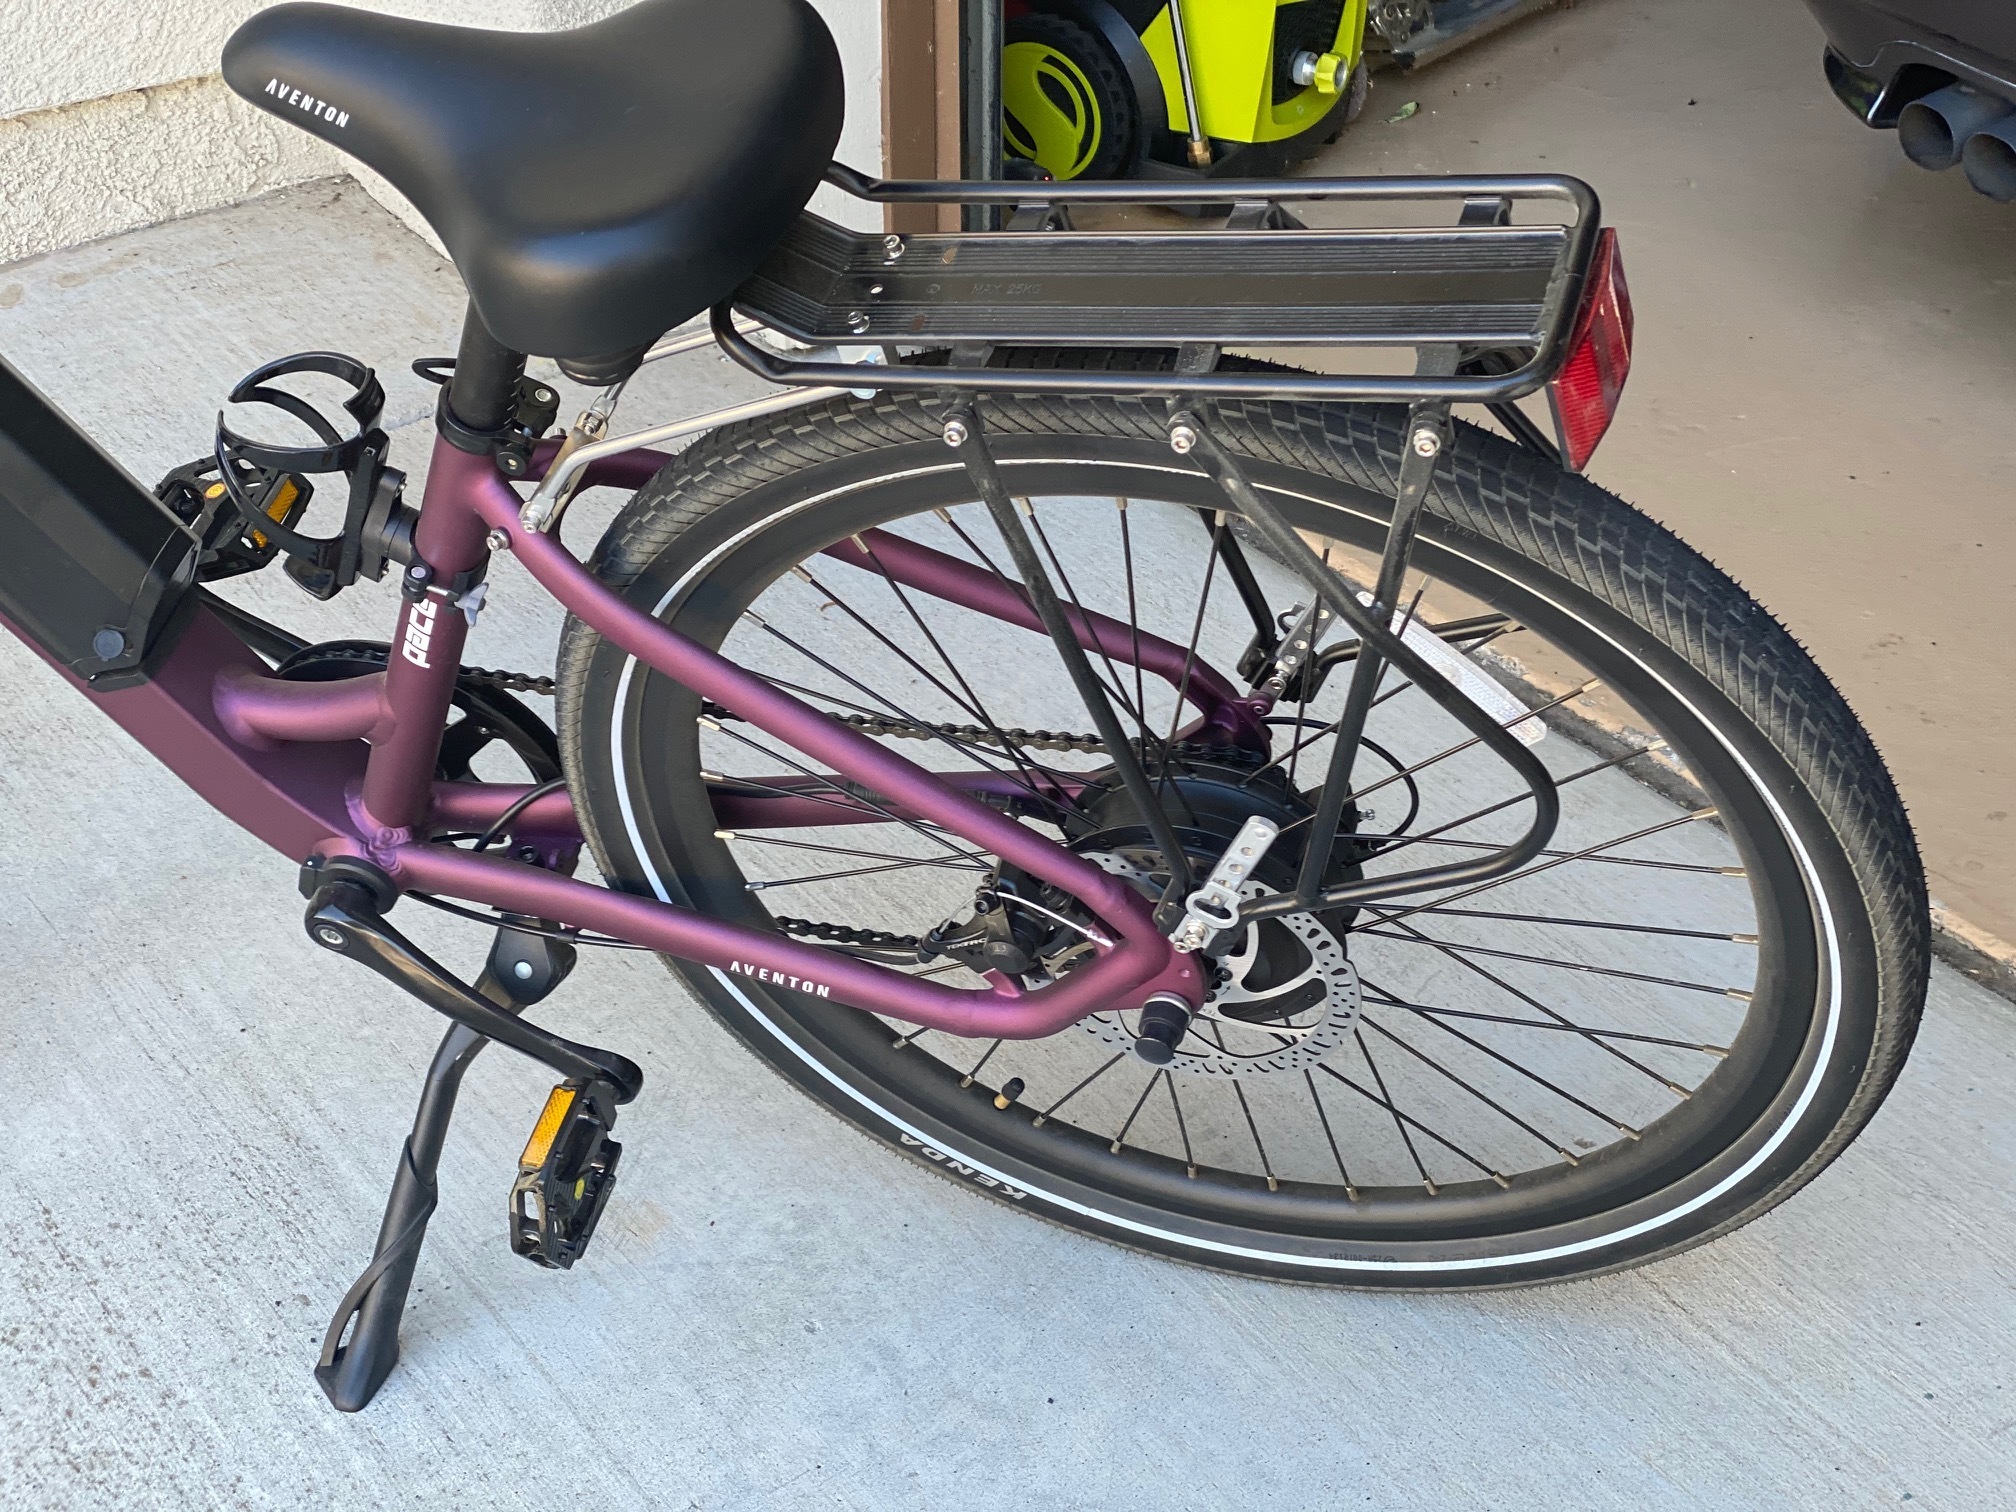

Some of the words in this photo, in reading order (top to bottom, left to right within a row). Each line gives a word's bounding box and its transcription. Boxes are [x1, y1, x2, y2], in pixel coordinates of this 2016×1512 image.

[264, 78, 350, 128] AVENTON
[730, 960, 830, 998] AVENTON
[900, 1133, 1027, 1200] KENDA
